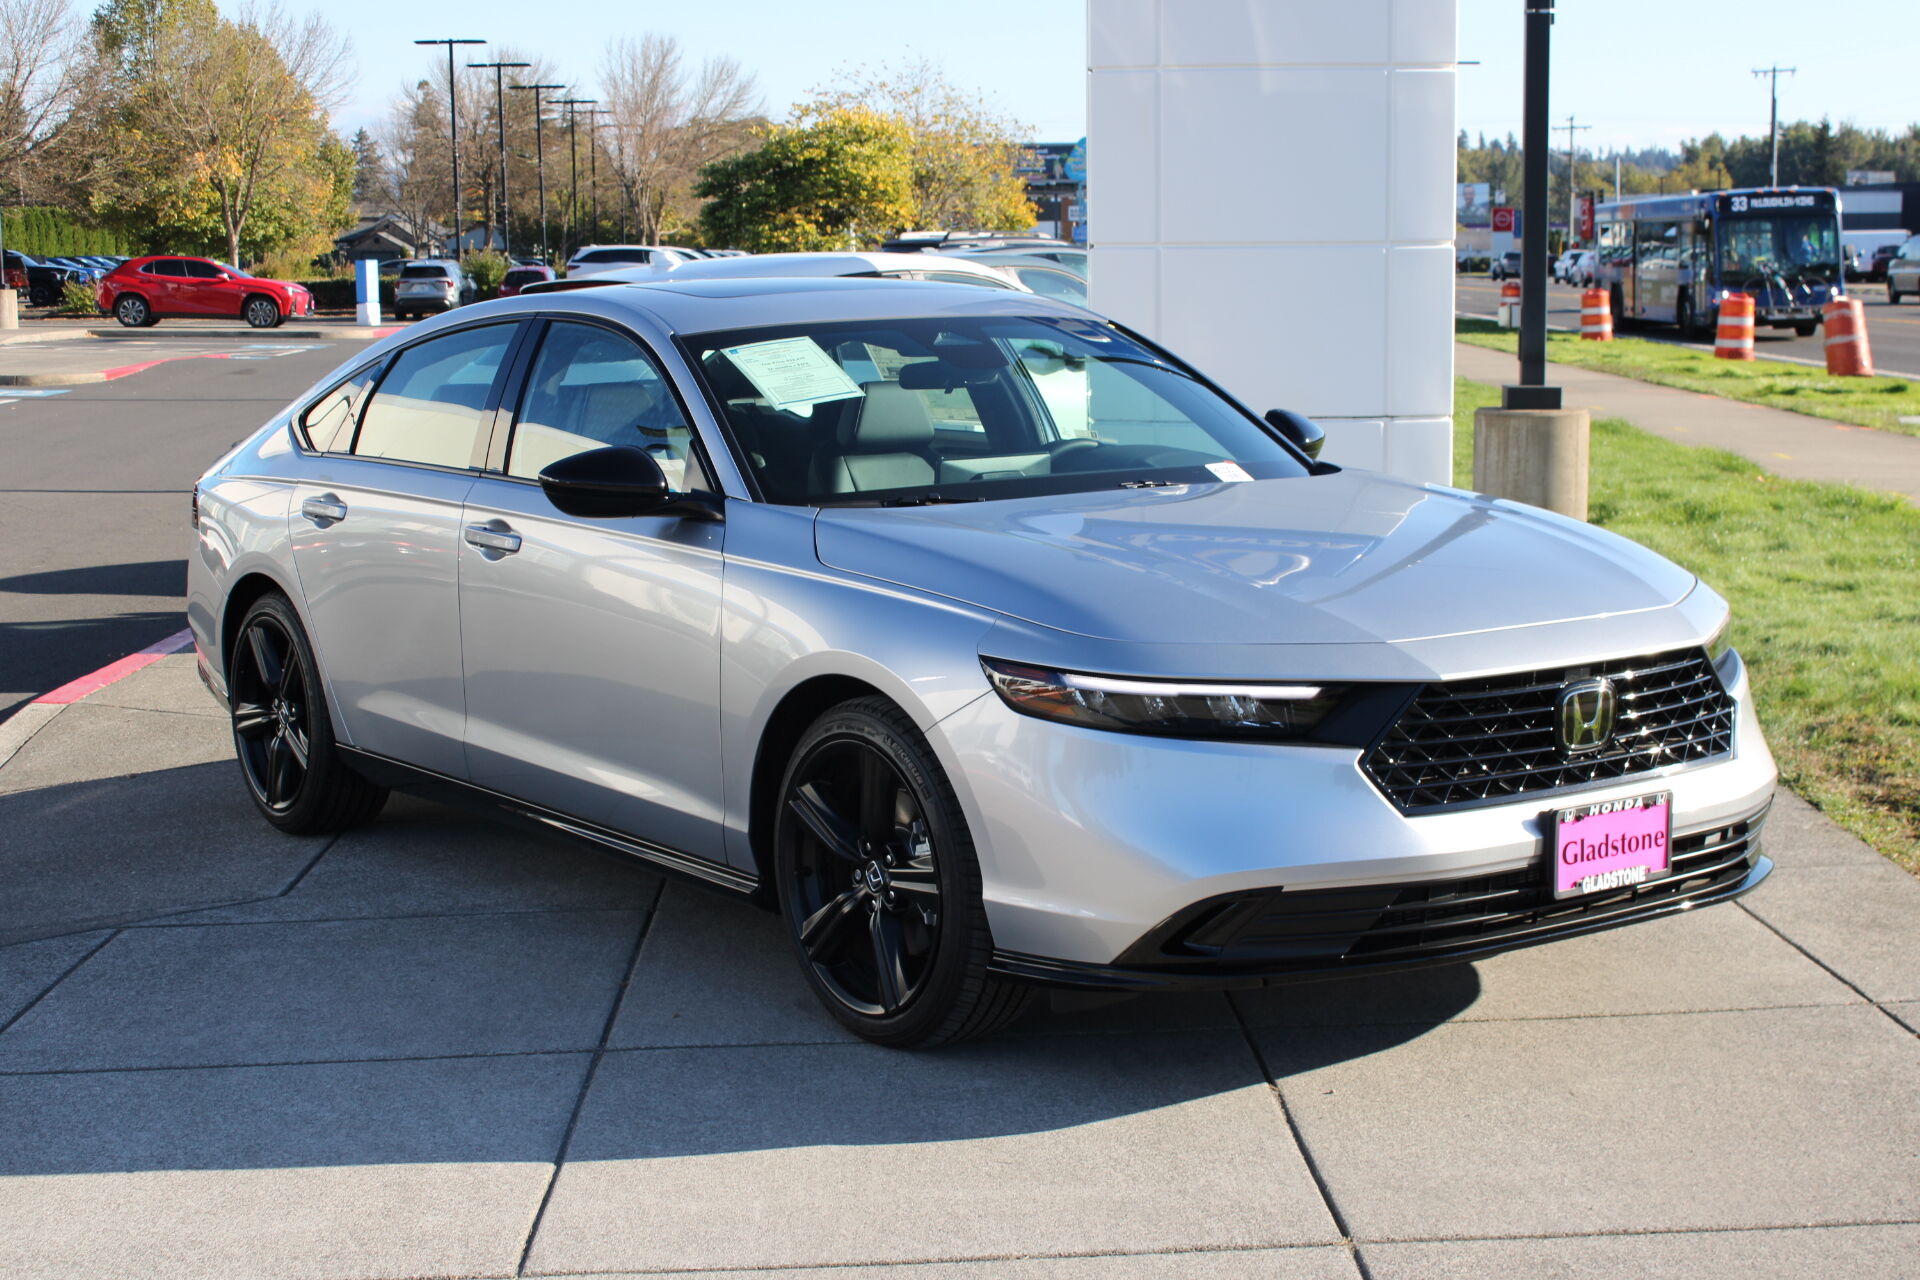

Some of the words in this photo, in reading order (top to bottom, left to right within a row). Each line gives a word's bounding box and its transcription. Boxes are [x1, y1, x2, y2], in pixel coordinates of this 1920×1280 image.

[1731, 196, 1748, 212] 33
[1588, 797, 1644, 817] HONDA
[1562, 830, 1665, 866] Gladstone
[1582, 865, 1646, 894] GLADSTONE
